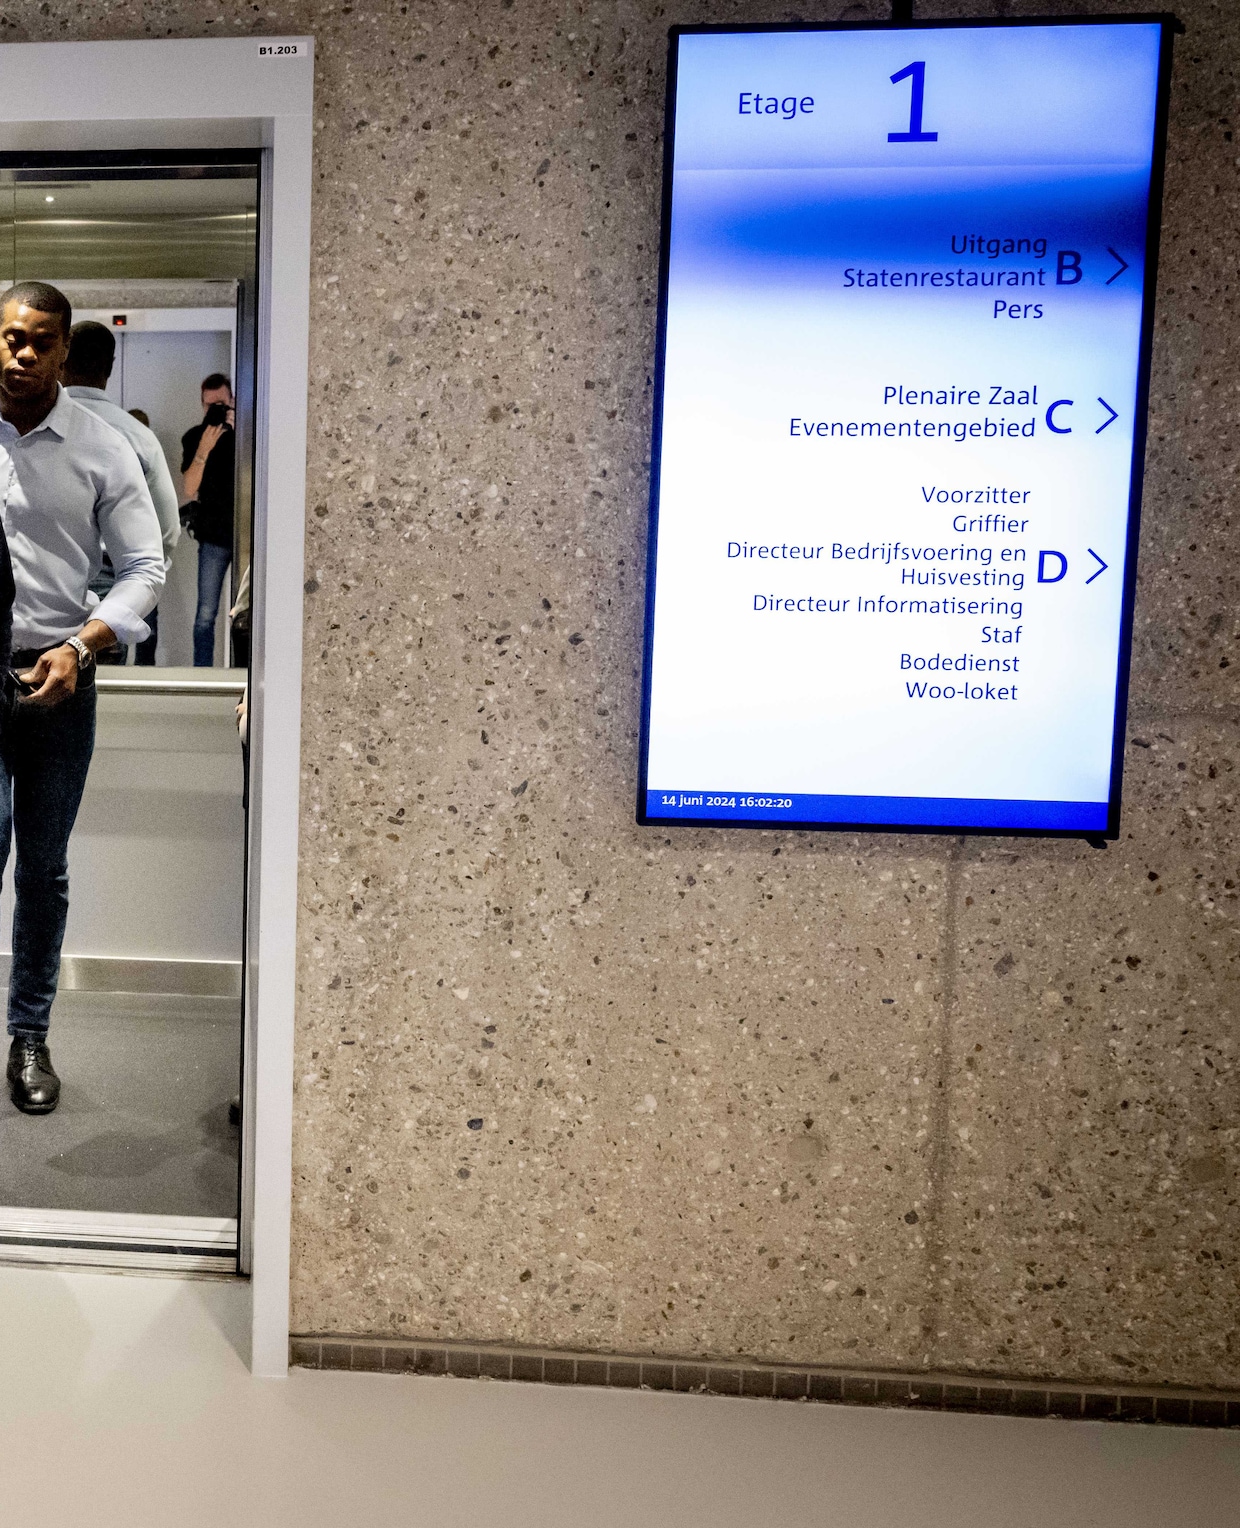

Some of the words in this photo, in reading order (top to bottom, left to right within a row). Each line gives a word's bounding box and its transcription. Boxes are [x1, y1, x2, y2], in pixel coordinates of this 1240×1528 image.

[260, 46, 297, 55] B1.203
[739, 93, 814, 119] Etage
[888, 61, 938, 142] 1
[952, 235, 1047, 258] Uitgang
[844, 268, 1046, 287] Statenrestaurant
[1056, 251, 1082, 285] B
[994, 300, 1042, 318] Pers
[885, 386, 980, 404] Plenaire
[989, 386, 1037, 404] Zaal
[1046, 400, 1073, 433] C
[791, 418, 1035, 441] Evenementengebied
[922, 487, 1030, 503] Voorzitter
[954, 515, 1028, 532] Griffier
[728, 543, 823, 558] Directeur
[833, 543, 991, 565] Bedrijfsvoering
[1001, 549, 1025, 561] en
[1038, 551, 1067, 583] D
[902, 569, 1024, 590] Huisvesting
[754, 595, 849, 611] Directeur
[859, 595, 1022, 619] Informatisering
[982, 626, 1022, 643] Staf
[901, 653, 1019, 671] Bodedienst
[906, 682, 1017, 700] Woo-loket
[662, 796, 676, 806] 14
[679, 795, 703, 807] juni
[707, 797, 736, 807] 2024
[740, 797, 792, 807] 16:02:20
